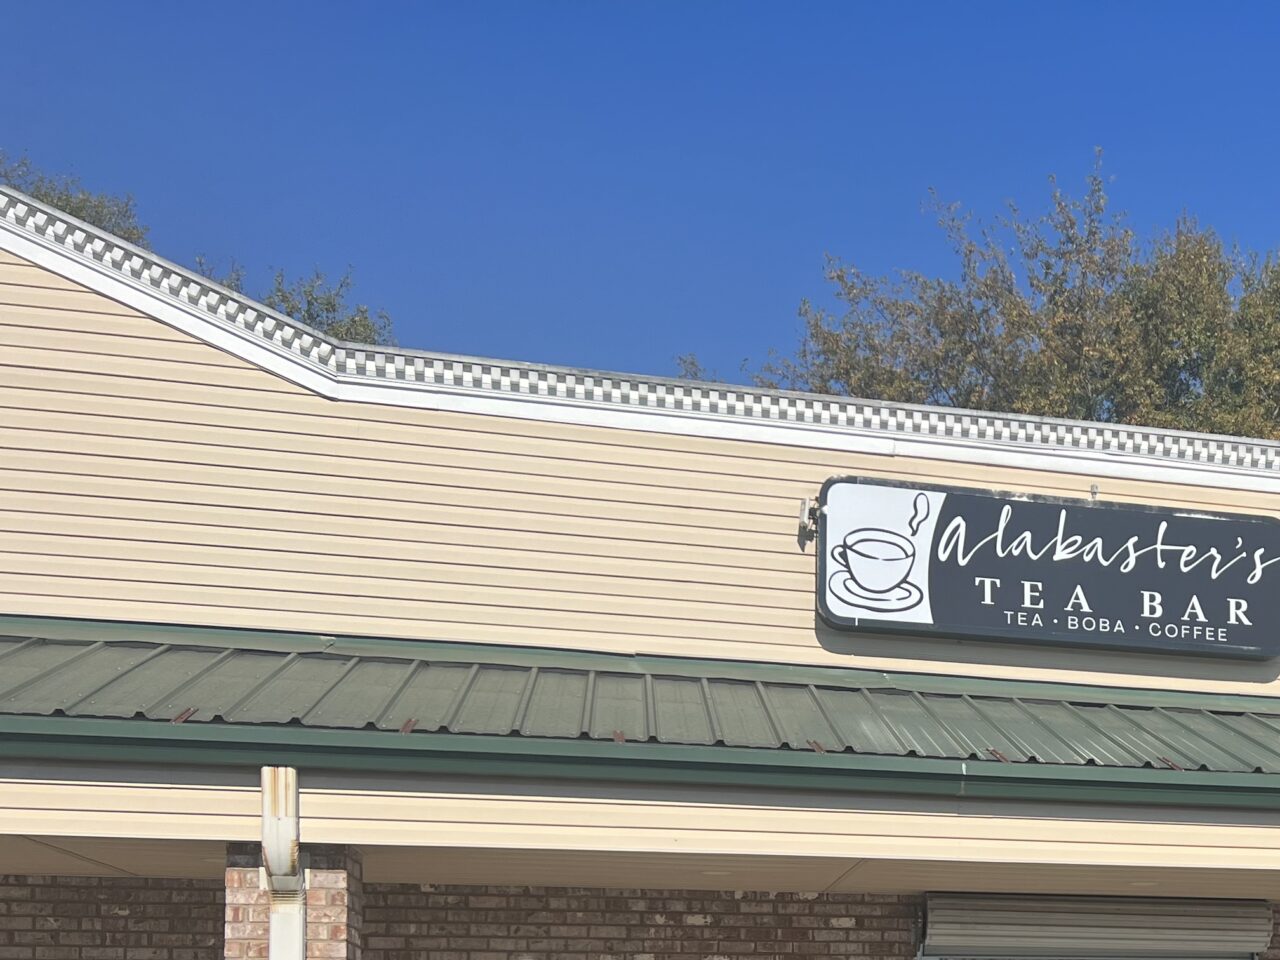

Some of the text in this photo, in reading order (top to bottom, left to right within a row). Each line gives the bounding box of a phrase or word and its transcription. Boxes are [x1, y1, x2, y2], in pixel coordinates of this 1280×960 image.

[974, 576, 1253, 626] TEA BAR
[1003, 610, 1228, 642] TEA BOBA COFFEE
